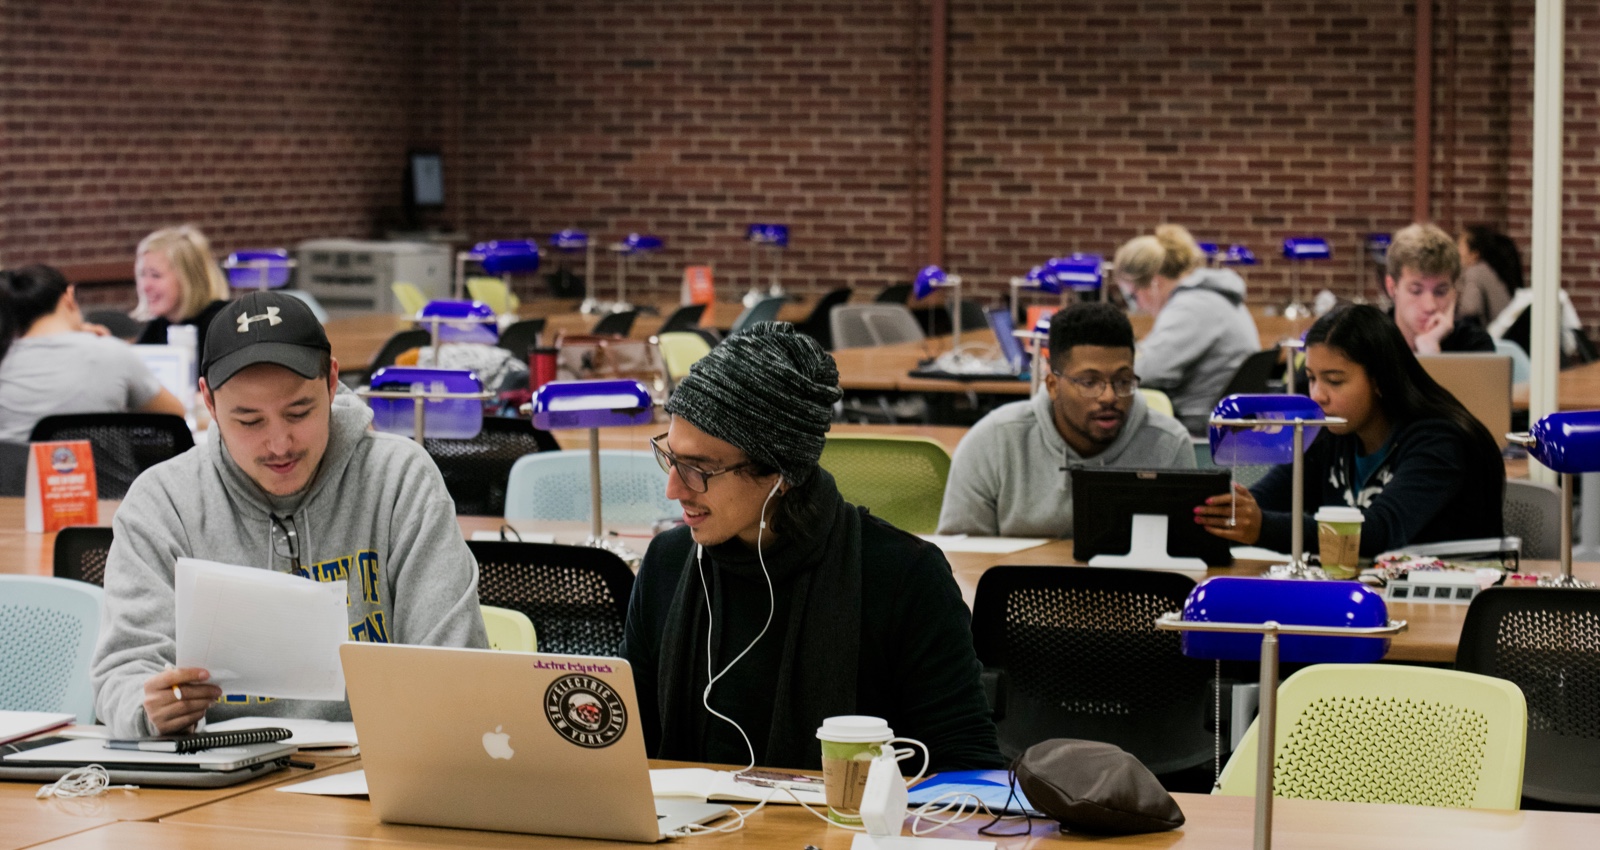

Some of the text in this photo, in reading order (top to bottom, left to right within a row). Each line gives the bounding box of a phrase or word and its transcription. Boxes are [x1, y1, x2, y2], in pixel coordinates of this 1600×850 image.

[554, 677, 623, 731] ELECTRIC LADY
[571, 730, 604, 744] YORK
